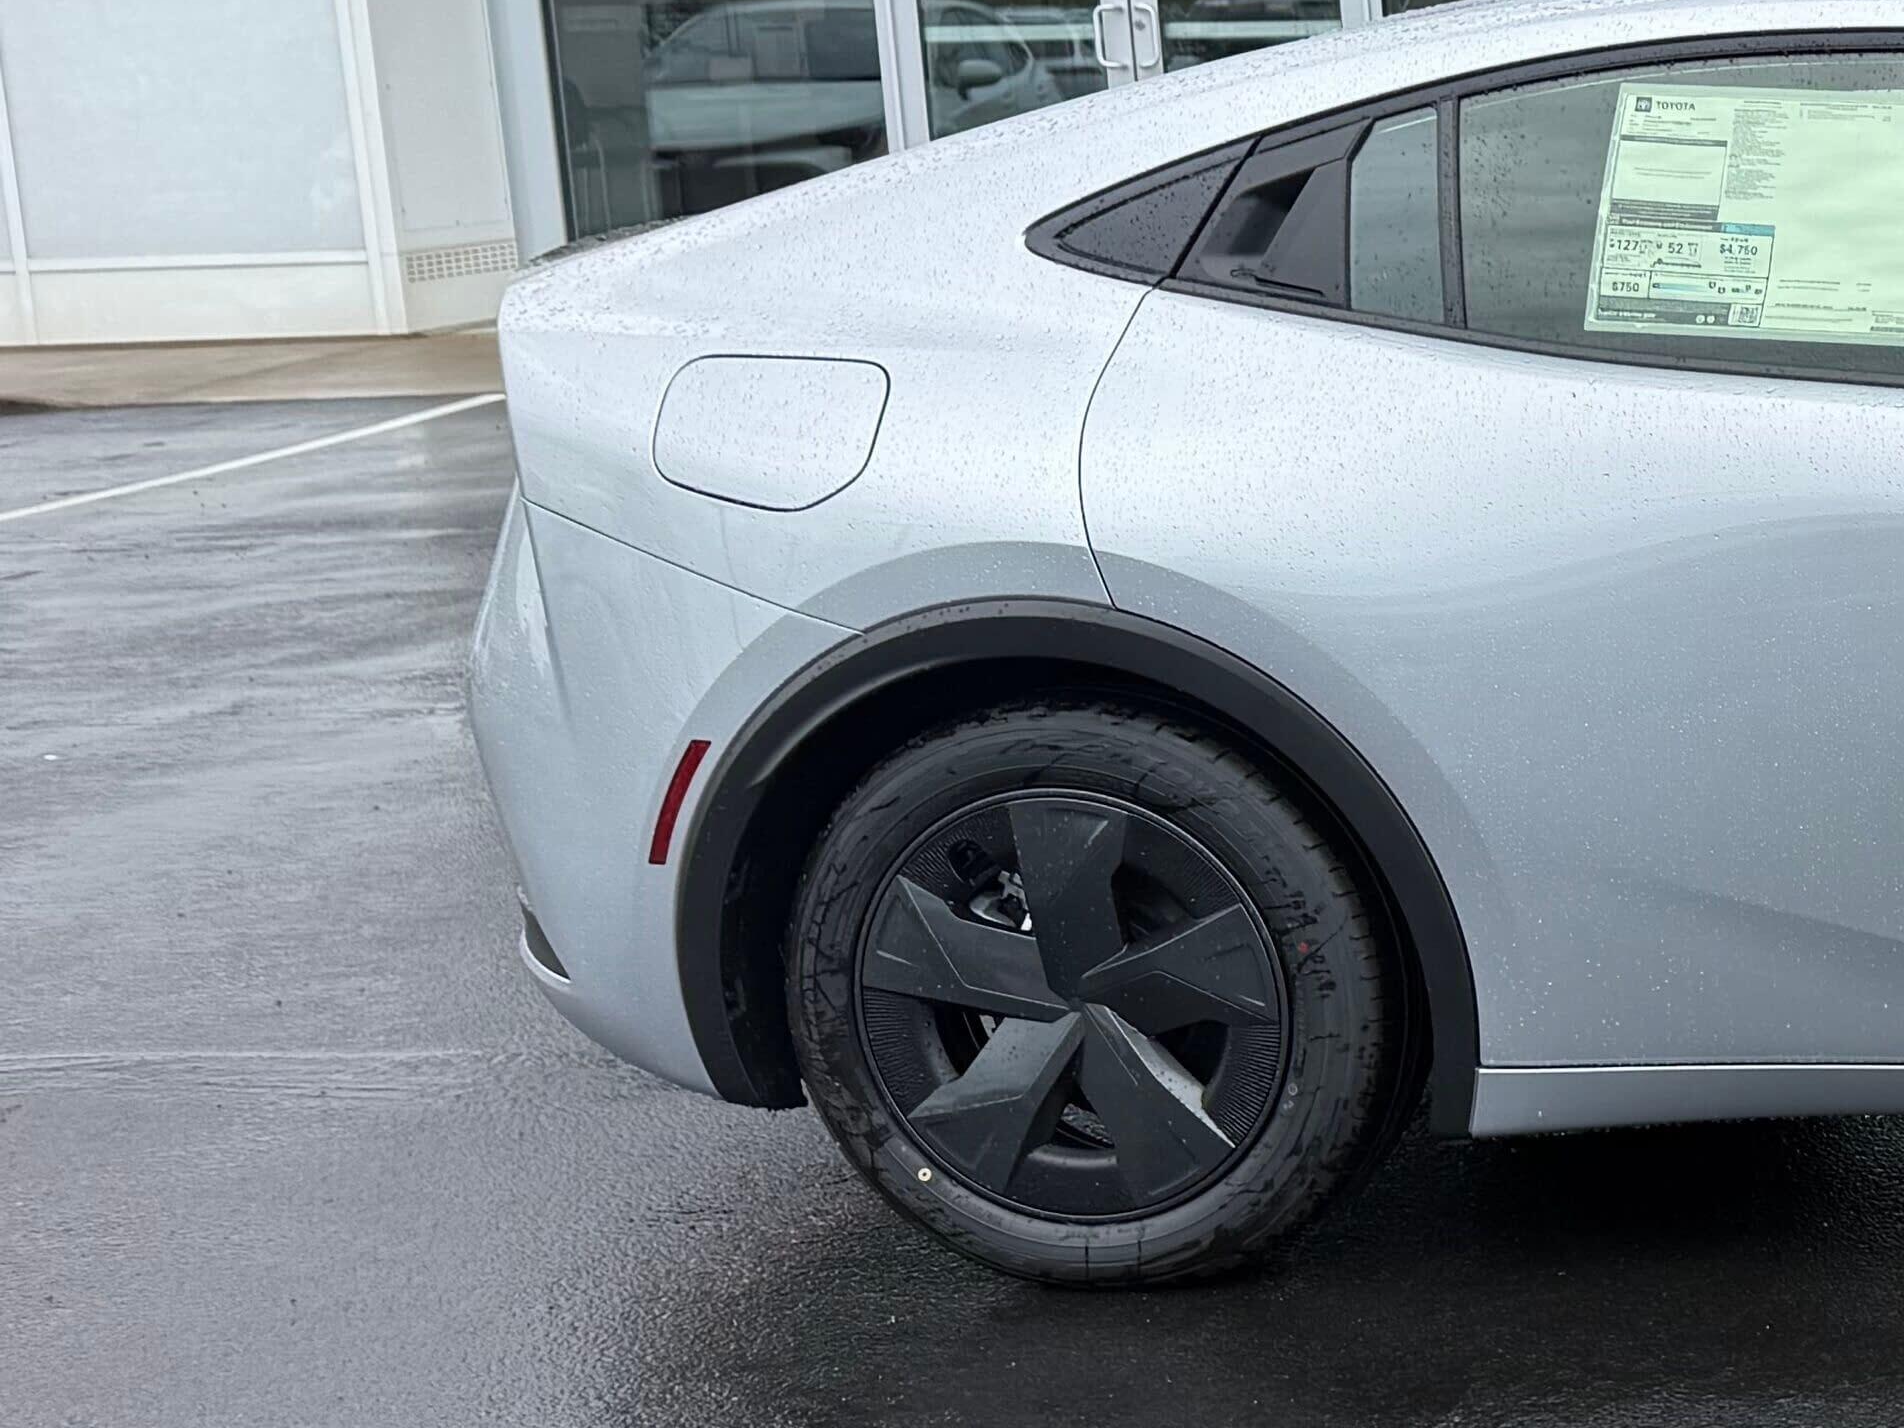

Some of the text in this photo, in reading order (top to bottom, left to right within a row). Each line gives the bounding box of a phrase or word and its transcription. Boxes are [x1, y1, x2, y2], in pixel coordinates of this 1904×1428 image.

[1655, 99, 1697, 112] TOYOTA
[1616, 239, 1639, 252] 127
[1667, 242, 1684, 254] 52
